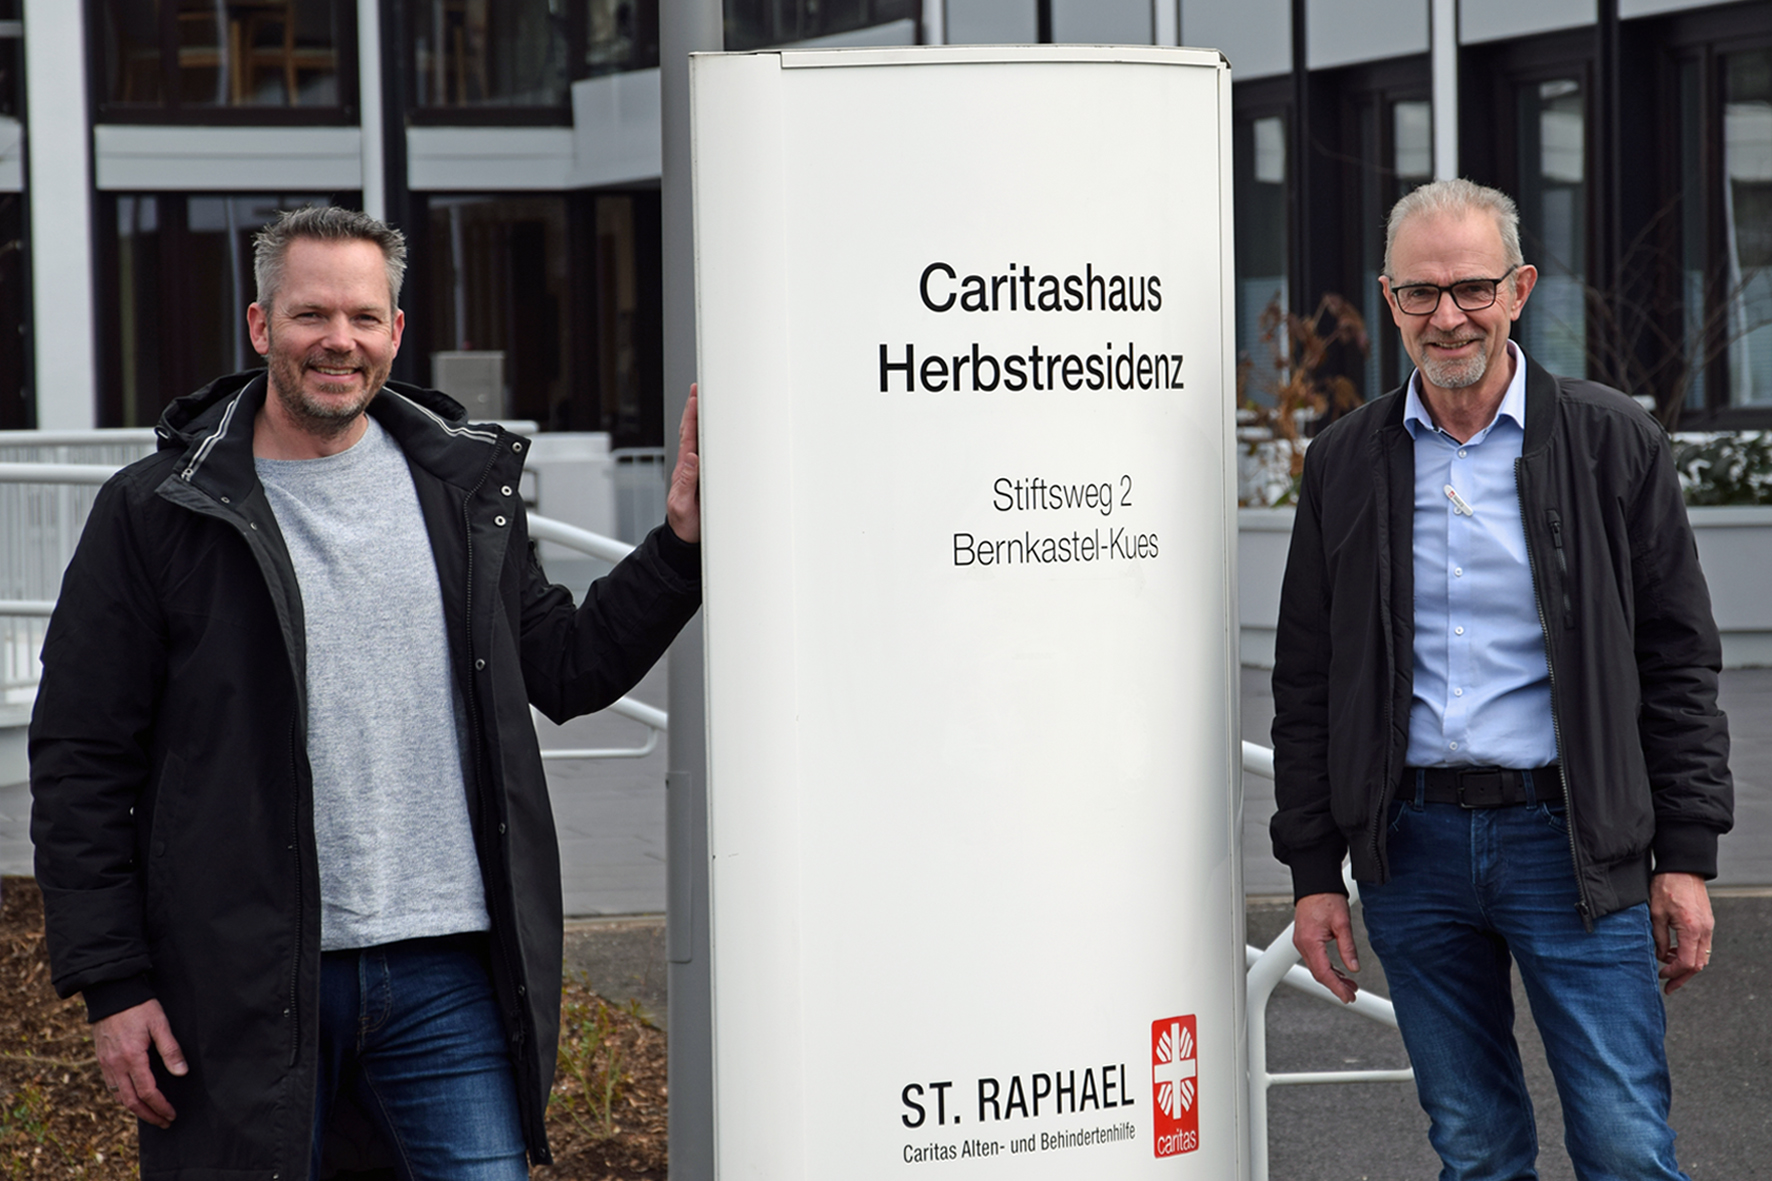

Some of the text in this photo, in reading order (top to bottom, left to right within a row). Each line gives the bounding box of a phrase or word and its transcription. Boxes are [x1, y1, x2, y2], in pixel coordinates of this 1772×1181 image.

[920, 262, 1162, 312] Caritashaus
[880, 342, 1184, 392] Herbstresidenz
[994, 475, 1132, 516] Stiftsweg 2
[954, 527, 1158, 566] Bernkastel-Kues
[902, 1064, 1134, 1128] ST. RAPHAEL
[904, 1122, 1135, 1163] Caritas Alten- und Behindertenhilfe
[1157, 1129, 1196, 1154] caritas
